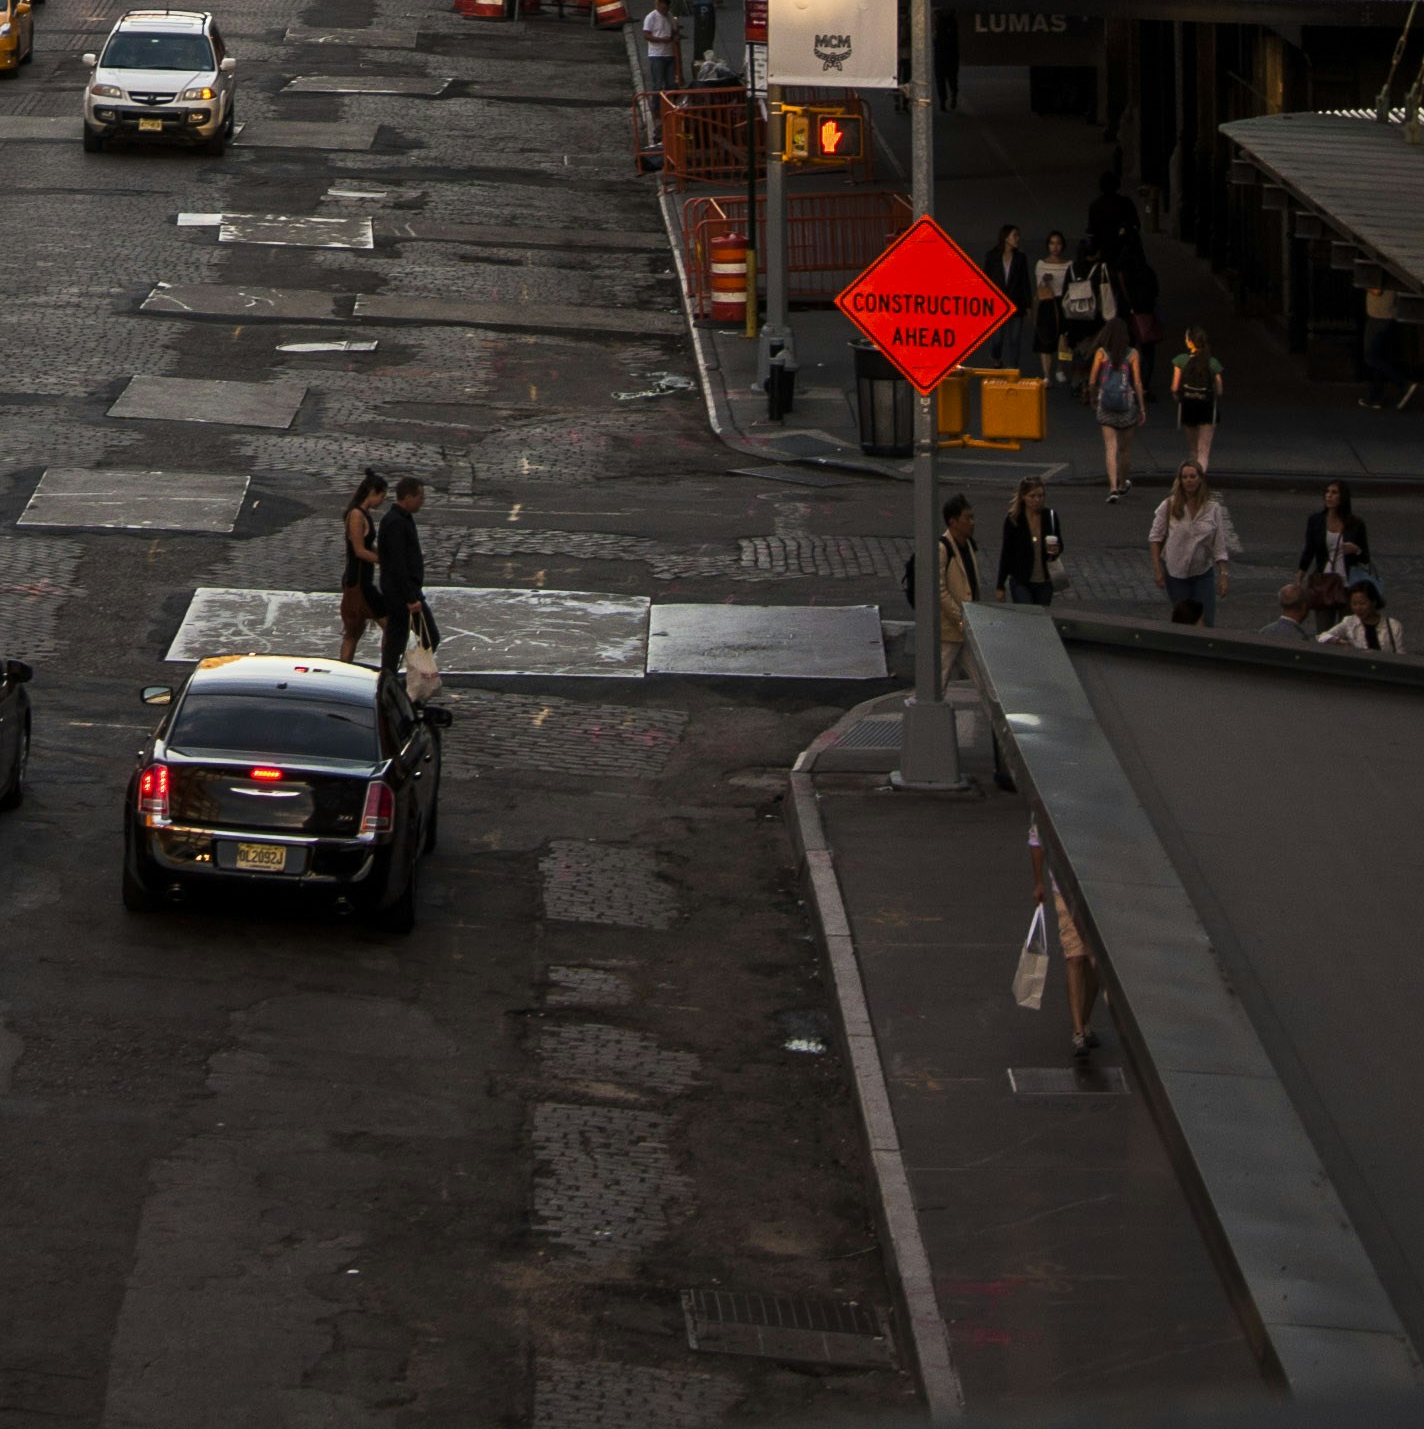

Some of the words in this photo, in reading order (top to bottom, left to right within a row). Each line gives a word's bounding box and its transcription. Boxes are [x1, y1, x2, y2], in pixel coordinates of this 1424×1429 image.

[974, 12, 1068, 33] LUMAS
[814, 34, 852, 48] MCM
[852, 292, 995, 317] CONSTRUCTION
[891, 326, 957, 348] AHEAD
